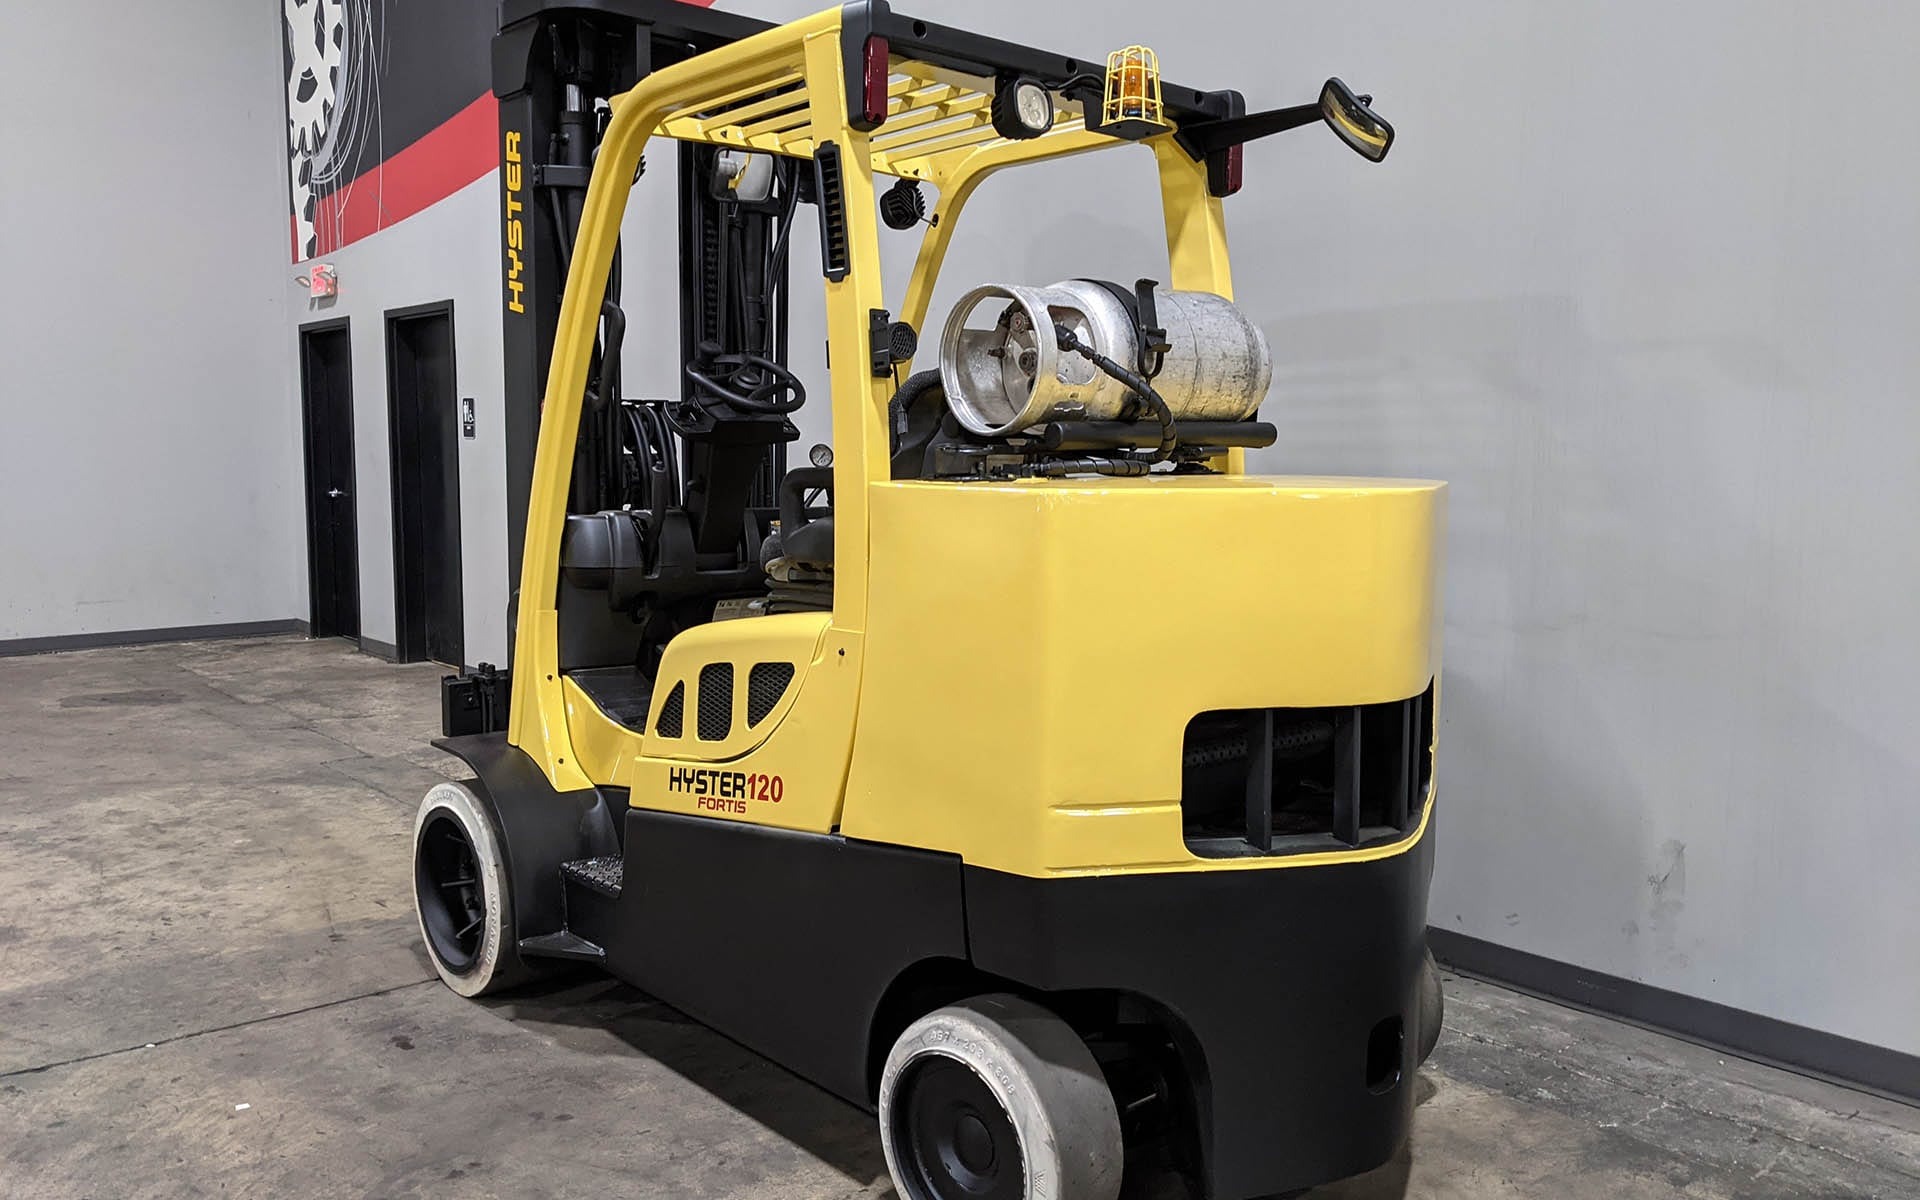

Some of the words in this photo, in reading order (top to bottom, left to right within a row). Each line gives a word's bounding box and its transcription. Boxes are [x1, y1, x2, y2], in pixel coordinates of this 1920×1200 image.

[506, 131, 525, 315] HYSTER
[669, 767, 746, 799] HYSTER
[747, 773, 783, 803] 120
[697, 797, 747, 814] FORTIS
